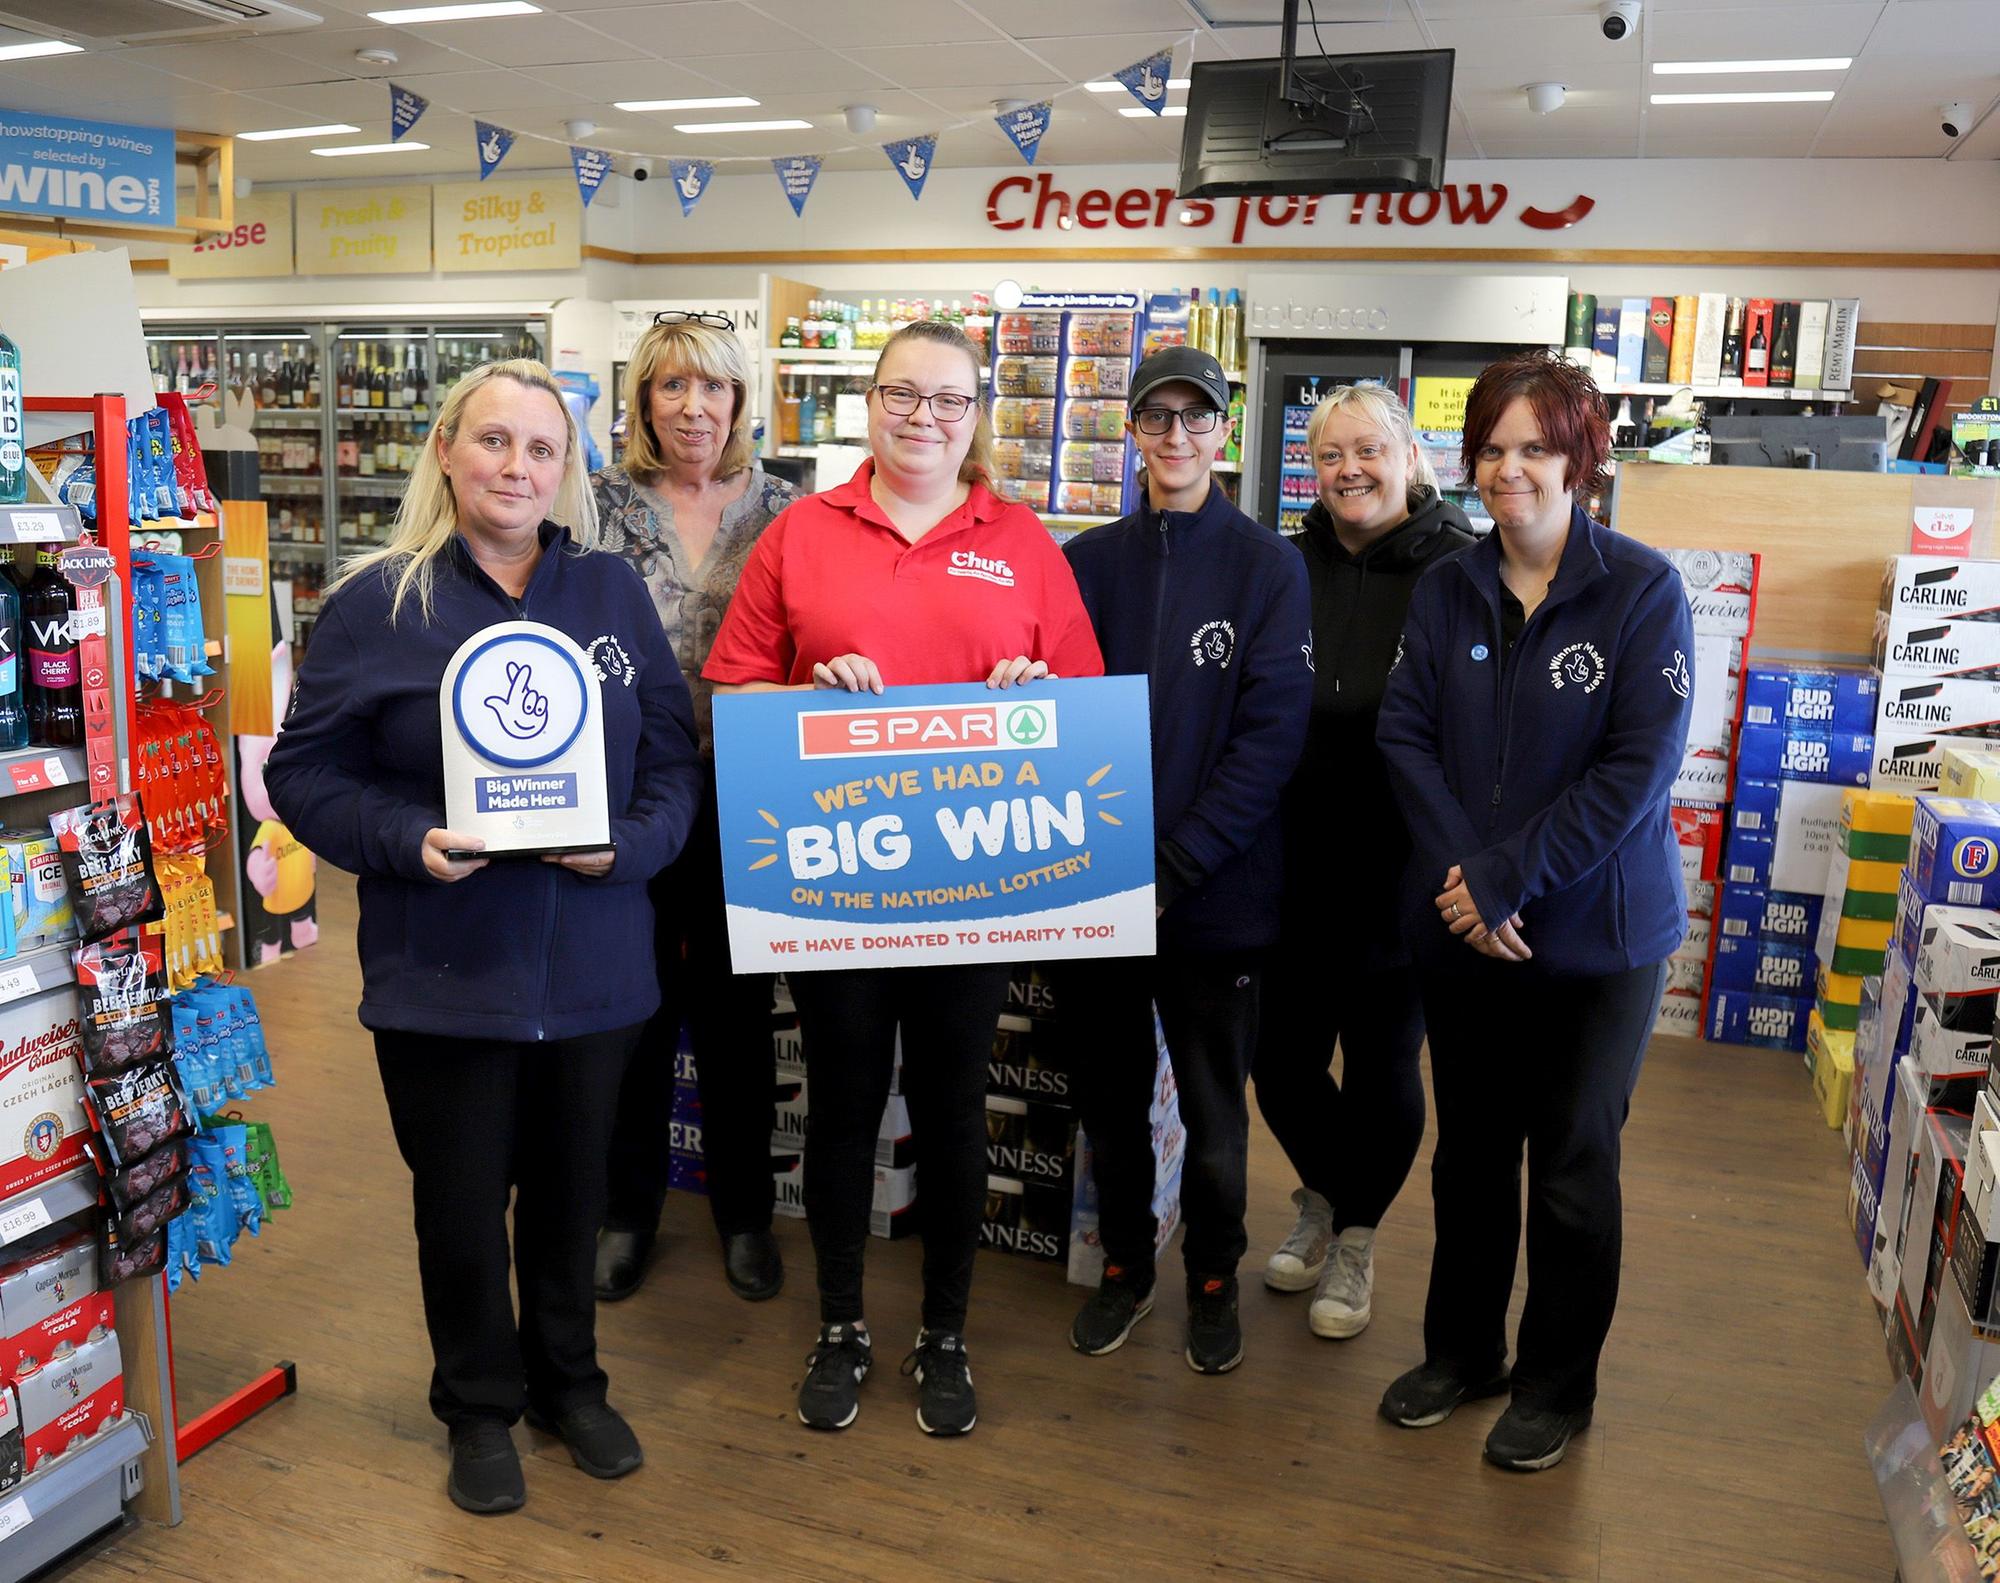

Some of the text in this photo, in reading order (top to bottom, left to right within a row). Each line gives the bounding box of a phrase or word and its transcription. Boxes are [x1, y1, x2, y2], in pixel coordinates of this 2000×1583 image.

[0, 122, 153, 155] howstopping wines
[33, 149, 106, 169] selected by
[0, 163, 160, 216] wine RACK
[463, 191, 545, 223] Silky &
[986, 172, 1215, 231] Cheers
[1349, 183, 1509, 226] now
[320, 206, 384, 230] Fresh
[193, 220, 267, 253] ose
[329, 211, 398, 260] Fruity
[458, 222, 556, 256] Tropical
[1251, 299, 1390, 331] tobacco
[1833, 307, 1848, 350] MARTIN
[1, 374, 18, 433] WKD
[1300, 384, 1326, 406] blu
[1440, 388, 1461, 398] It is
[1429, 401, 1464, 409] to sell
[1981, 398, 1999, 411] £1
[2, 450, 20, 460] BLUE
[17, 520, 45, 532] £3.29
[59, 558, 85, 571] JACK
[1689, 595, 1749, 619] weiser
[1899, 586, 1968, 607] CARLING
[72, 616, 100, 629] £1.89
[30, 620, 74, 647] VK
[1190, 621, 1221, 647] Winner
[43, 660, 68, 669] BLACK
[1193, 648, 1206, 667] Big
[1892, 644, 1960, 665] CARLING
[41, 667, 71, 675] CHERRY
[1549, 641, 1606, 694] Big Winner Made Here
[1791, 687, 1832, 705] BUD
[1785, 701, 1835, 720] LIGHT
[1885, 701, 1952, 722] CARLING
[847, 712, 995, 746] SPAR
[1786, 740, 1827, 758] BUD
[1781, 753, 1830, 772] LIGHT
[1878, 758, 1942, 779] CARLING
[486, 778, 566, 796] Big Winner
[812, 760, 1041, 814] WE'VE HAD A
[488, 793, 567, 810] Made Here
[1700, 812, 1711, 824] 20
[1800, 817, 1838, 829] Budlight
[785, 790, 1086, 881] BIG WIN
[1964, 845, 1986, 869] F
[40, 865, 62, 881] ICE
[791, 851, 1092, 909] ON THE NATIONAL LOTTERY
[1695, 884, 1706, 895] 20
[1767, 902, 1806, 920] BUD
[1760, 916, 1808, 935] LIGHT
[769, 924, 1116, 954] WE HAVE DONATED TO CHARITY TOO!
[1684, 964, 1695, 973] 20
[1762, 956, 1800, 973] BUD
[1755, 968, 1803, 988] LIGHT
[1747, 1006, 1796, 1026] LIGHT
[1750, 1022, 1789, 1039] BUD
[28, 1039, 85, 1073] Budvar
[3, 1073, 76, 1109] CZECH LAGER
[21, 1072, 56, 1090] ORIGINAL
[134, 1070, 166, 1098] JERKY
[5, 1178, 25, 1191] OWNED
[25, 1173, 33, 1182] BY
[33, 1169, 44, 1178] THE
[45, 1162, 61, 1174] CZECH
[3, 1210, 37, 1233] £16.99
[36, 1266, 80, 1293] Captain Morgan
[41, 1305, 82, 1331] Spiced Gold
[52, 1318, 77, 1335] COLA
[51, 1361, 93, 1390] Captain Morgan
[57, 1399, 96, 1427] Spiced Gold
[67, 1412, 90, 1429] COLA
